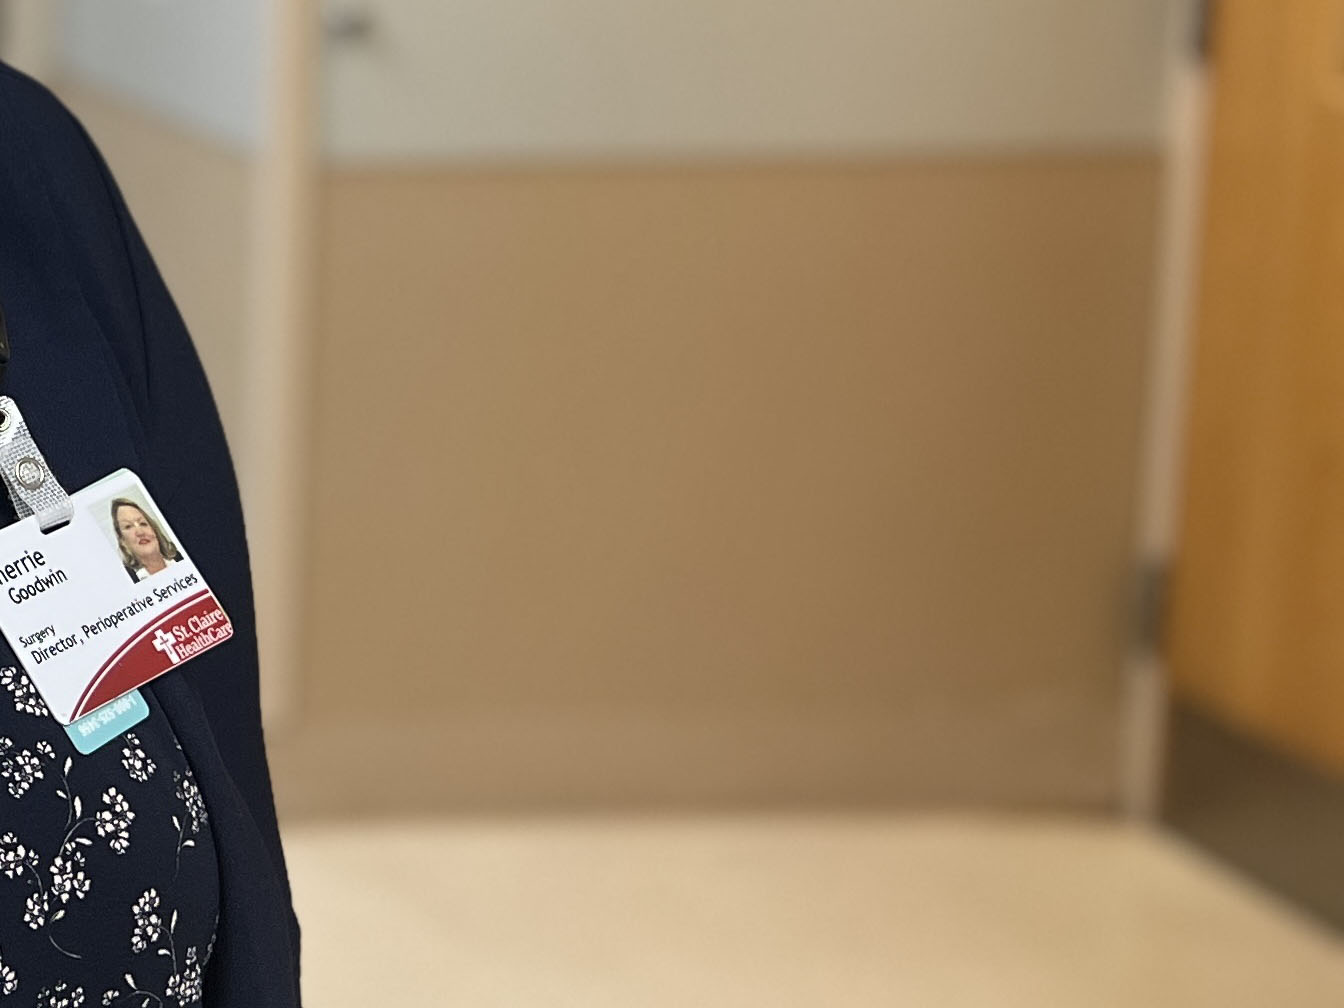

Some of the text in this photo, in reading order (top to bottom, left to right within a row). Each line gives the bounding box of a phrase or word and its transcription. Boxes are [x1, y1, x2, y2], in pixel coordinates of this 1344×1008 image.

[8, 568, 68, 604] Goodwin
[80, 595, 154, 640] Perioperative
[153, 573, 198, 603] Services
[18, 625, 56, 648] Surgery
[172, 608, 224, 642] St. Claire
[174, 622, 232, 660] HealthCare
